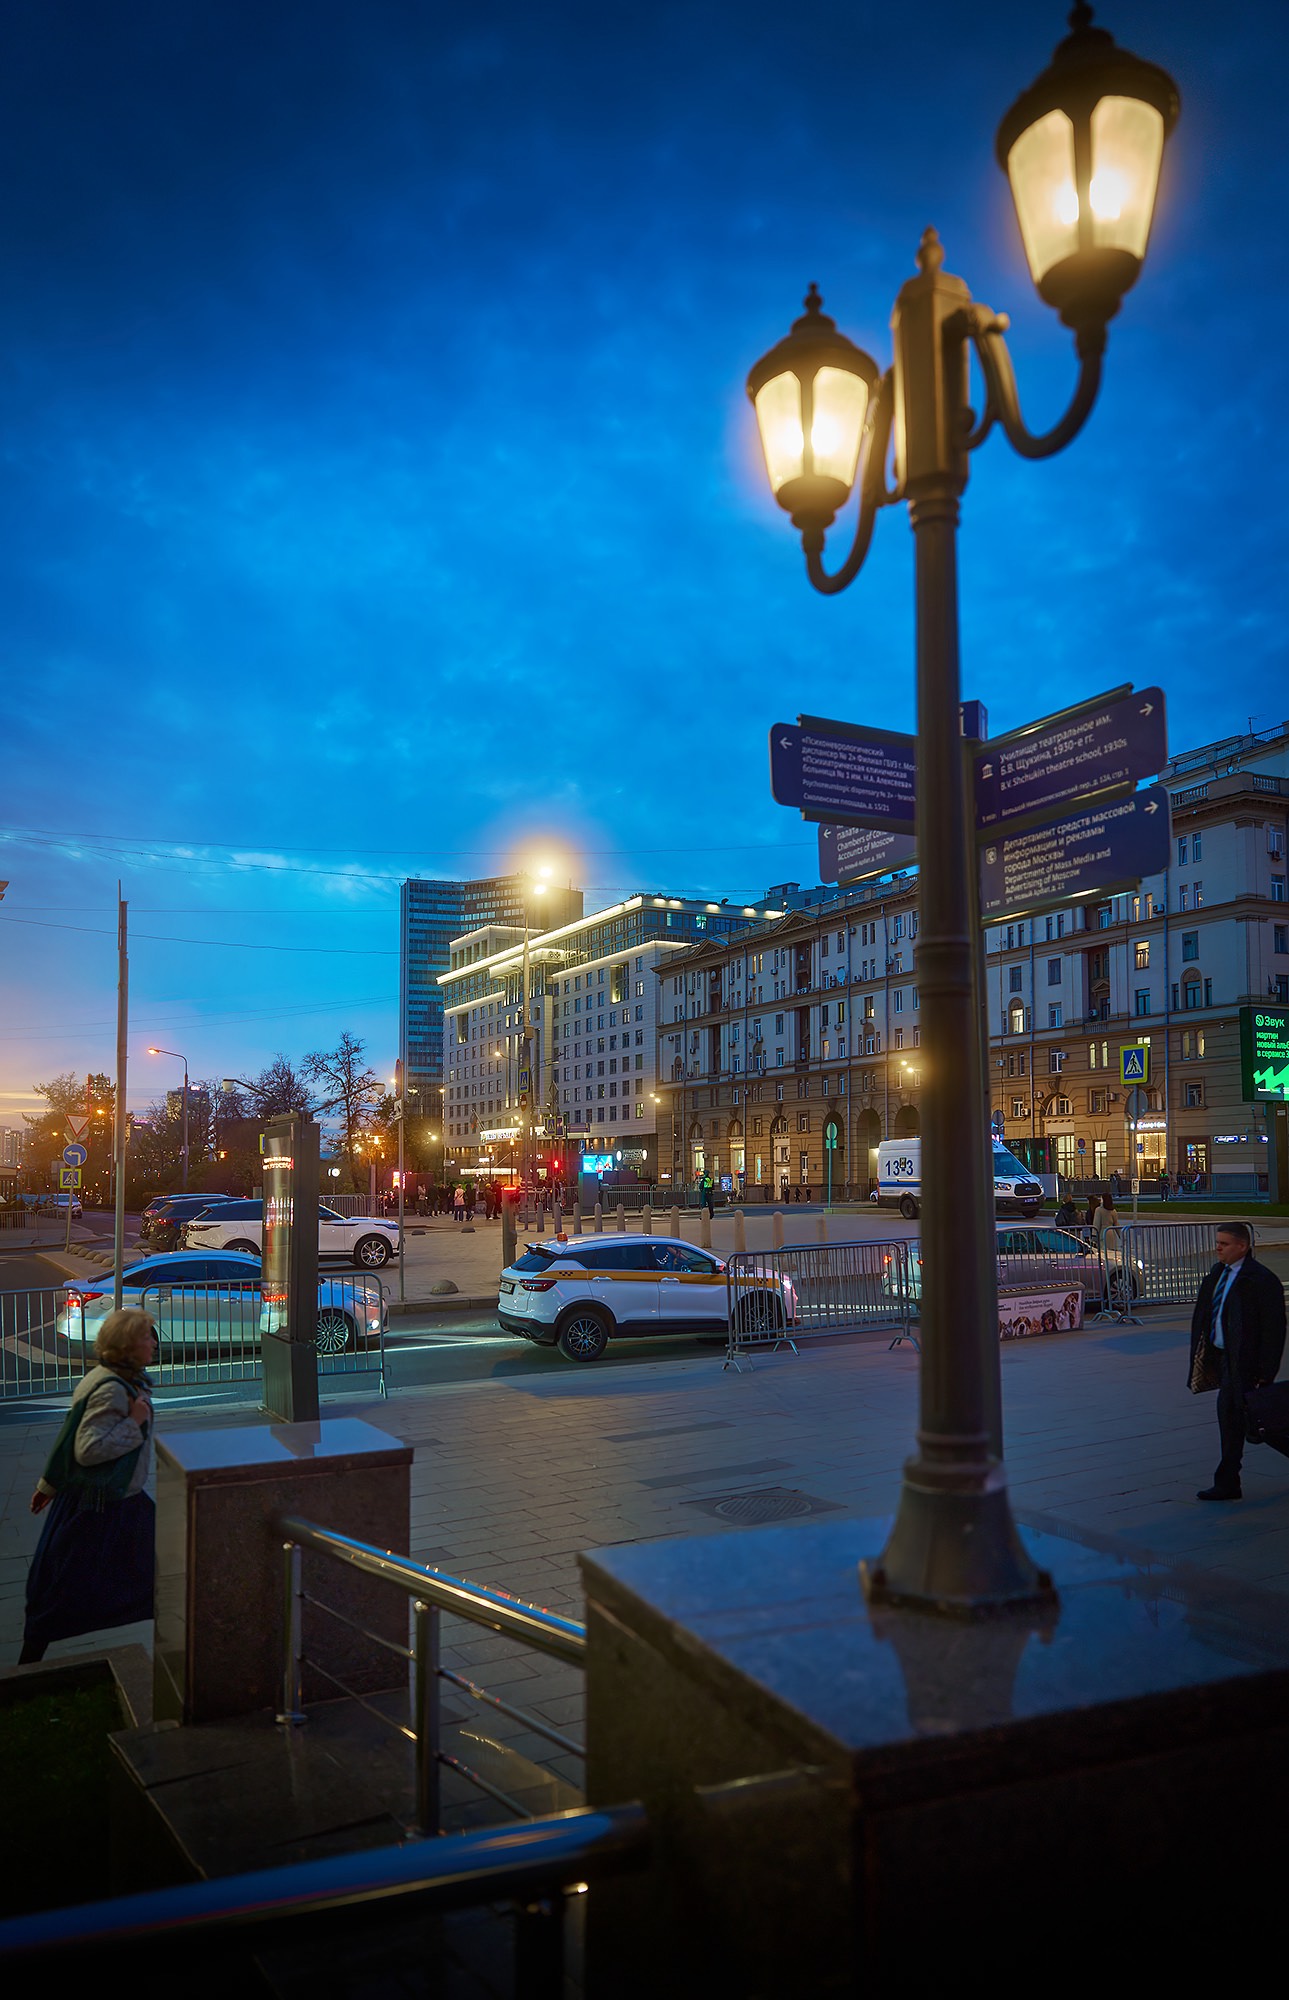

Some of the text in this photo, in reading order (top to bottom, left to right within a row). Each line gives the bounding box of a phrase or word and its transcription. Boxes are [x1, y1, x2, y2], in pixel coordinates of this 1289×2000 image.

[1000, 716, 1112, 764] Училище театральное им.
[1000, 764, 1016, 776] Б.В.
[1016, 752, 1052, 770] Щукина,
[1054, 738, 1084, 756] 1930-е
[1046, 760, 1074, 774] theatre
[1104, 738, 1128, 754] 1930s
[1004, 802, 1136, 852] Департамент средств массовой
[838, 836, 866, 852] Chambers
[866, 832, 872, 842] of
[838, 836, 896, 862] Accounts of Moscow
[1004, 840, 1058, 862] информации
[1066, 826, 1104, 848] рекламы
[1004, 850, 1064, 874] города Москвы
[1004, 848, 1112, 884] Department of Mass Media and
[1004, 870, 1080, 894] Advertising of Moscow
[1264, 1016, 1285, 1028] Звук
[1256, 1032, 1278, 1040] мартин
[1256, 1040, 1276, 1049] новый
[1262, 1051, 1285, 1060] сервисе
